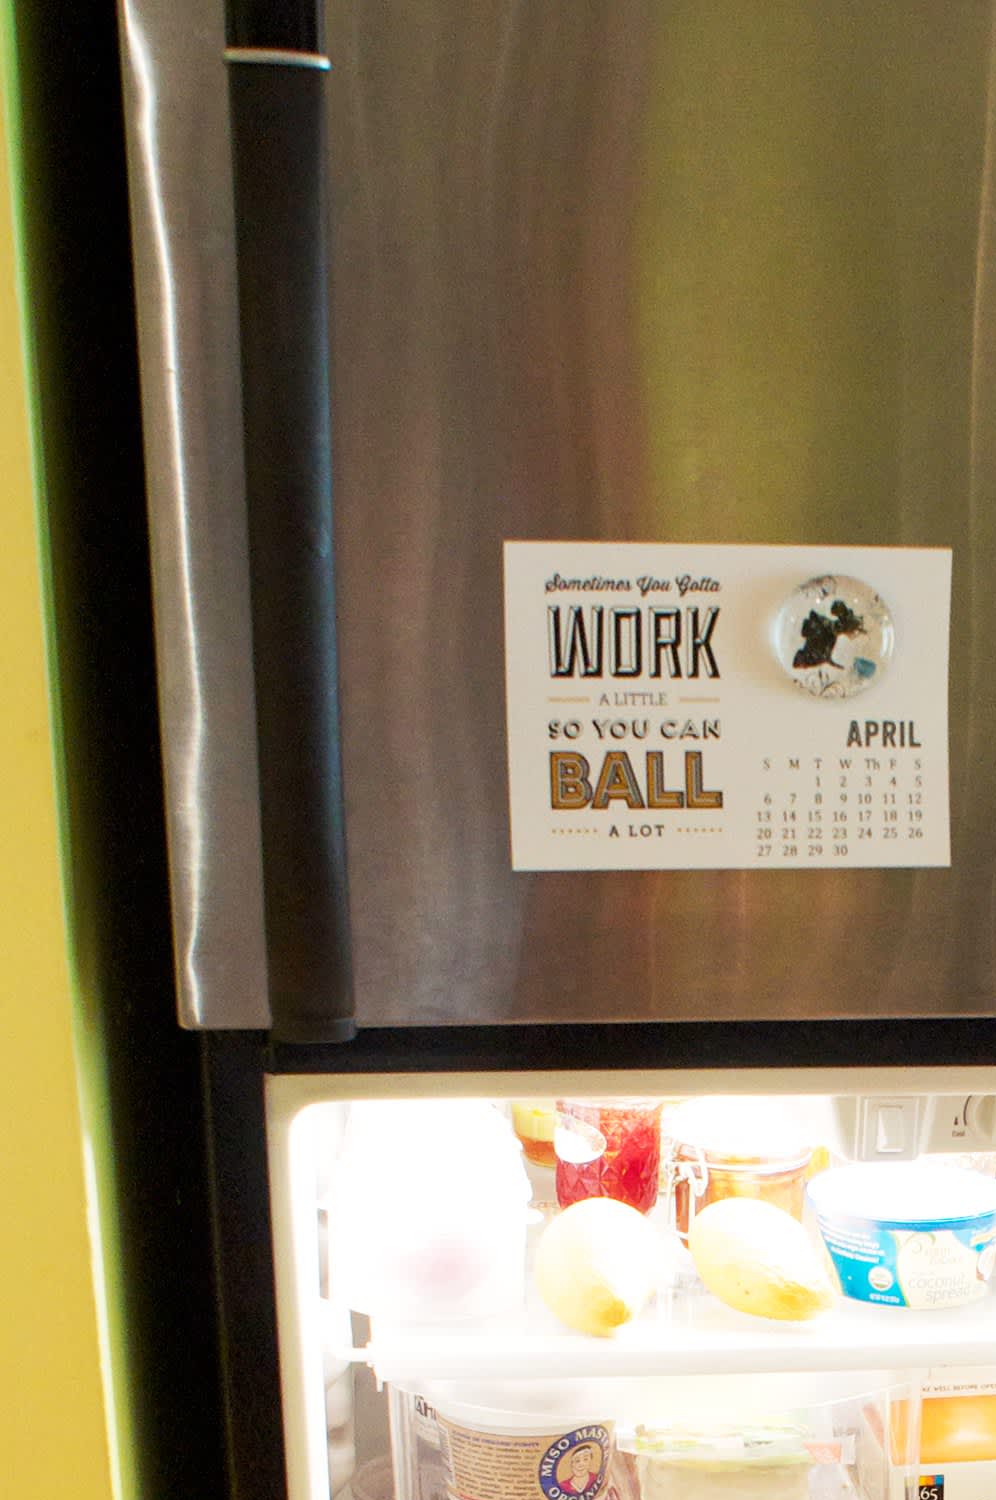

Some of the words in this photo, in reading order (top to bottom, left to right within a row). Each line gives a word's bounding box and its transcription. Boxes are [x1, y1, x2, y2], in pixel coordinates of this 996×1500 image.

[545, 573, 632, 594] Sometimes
[637, 575, 671, 597] You
[675, 574, 722, 597] Gotta
[547, 605, 721, 679] WORK
[600, 692, 610, 706] A
[614, 692, 668, 706] LITTLE
[547, 719, 581, 740] SO
[592, 719, 650, 740] YOU
[660, 719, 721, 740] CAN
[846, 720, 922, 748] APRIL
[763, 758, 771, 770] S
[789, 758, 800, 770] M
[814, 758, 822, 770] T
[839, 758, 852, 770] W
[864, 758, 880, 770] Th
[889, 758, 897, 770] F
[914, 758, 921, 770] S
[549, 750, 723, 810] BALL
[815, 776, 821, 787] 1
[840, 776, 847, 787] 2
[865, 776, 872, 787] 3
[889, 776, 897, 787] 4
[915, 776, 922, 787] 5
[764, 793, 772, 805] 6
[789, 793, 797, 805] 7
[814, 793, 822, 805] 8
[840, 793, 847, 805] 9
[857, 793, 872, 805] 10
[883, 793, 896, 805] 11
[908, 793, 922, 805] 12
[757, 811, 771, 822] 13
[782, 811, 796, 822] 14
[807, 811, 822, 822] 15
[832, 811, 847, 822] 16
[858, 811, 872, 822] 17
[883, 811, 897, 822] 18
[908, 811, 922, 822] 19
[609, 825, 619, 838] A
[629, 825, 665, 838] LOT
[757, 828, 772, 840] 20
[782, 828, 796, 840] 21
[807, 828, 823, 840] 22
[832, 828, 847, 840] 23
[857, 828, 873, 840] 24
[883, 828, 898, 840] 25
[908, 828, 923, 840] 26
[757, 845, 772, 857] 27
[782, 845, 798, 857] 28
[807, 845, 823, 857] 29
[833, 845, 848, 857] 30
[541, 1438, 571, 1478] MISO
